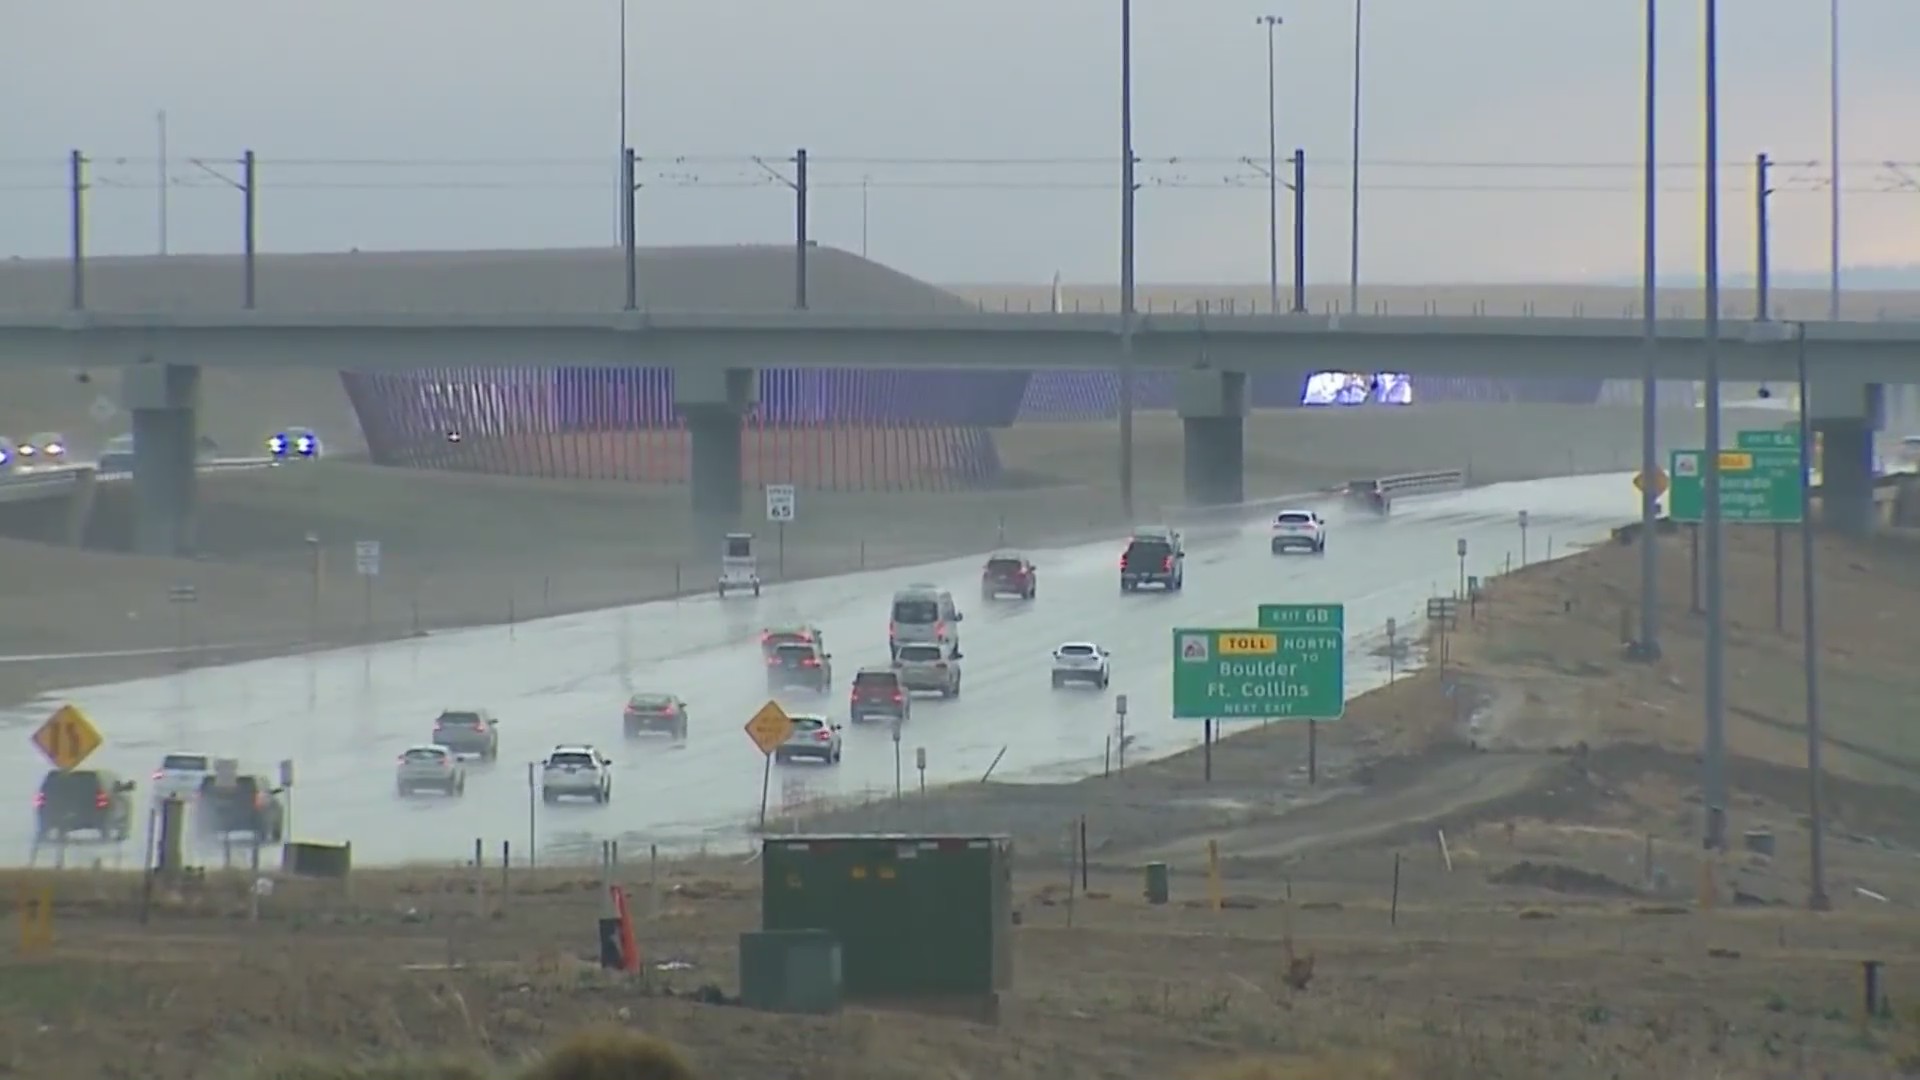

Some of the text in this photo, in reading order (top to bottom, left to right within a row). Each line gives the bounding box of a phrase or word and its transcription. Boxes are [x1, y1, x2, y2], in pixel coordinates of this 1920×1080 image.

[771, 505, 791, 517] 65
[1272, 608, 1328, 623] EXIT 6B
[1227, 638, 1337, 649] TOLL NORTH
[1302, 653, 1319, 662] TO
[1219, 661, 1298, 677] Boulder
[1207, 681, 1310, 697] Ft. Collins
[1224, 703, 1293, 714] NEXT EXIT
